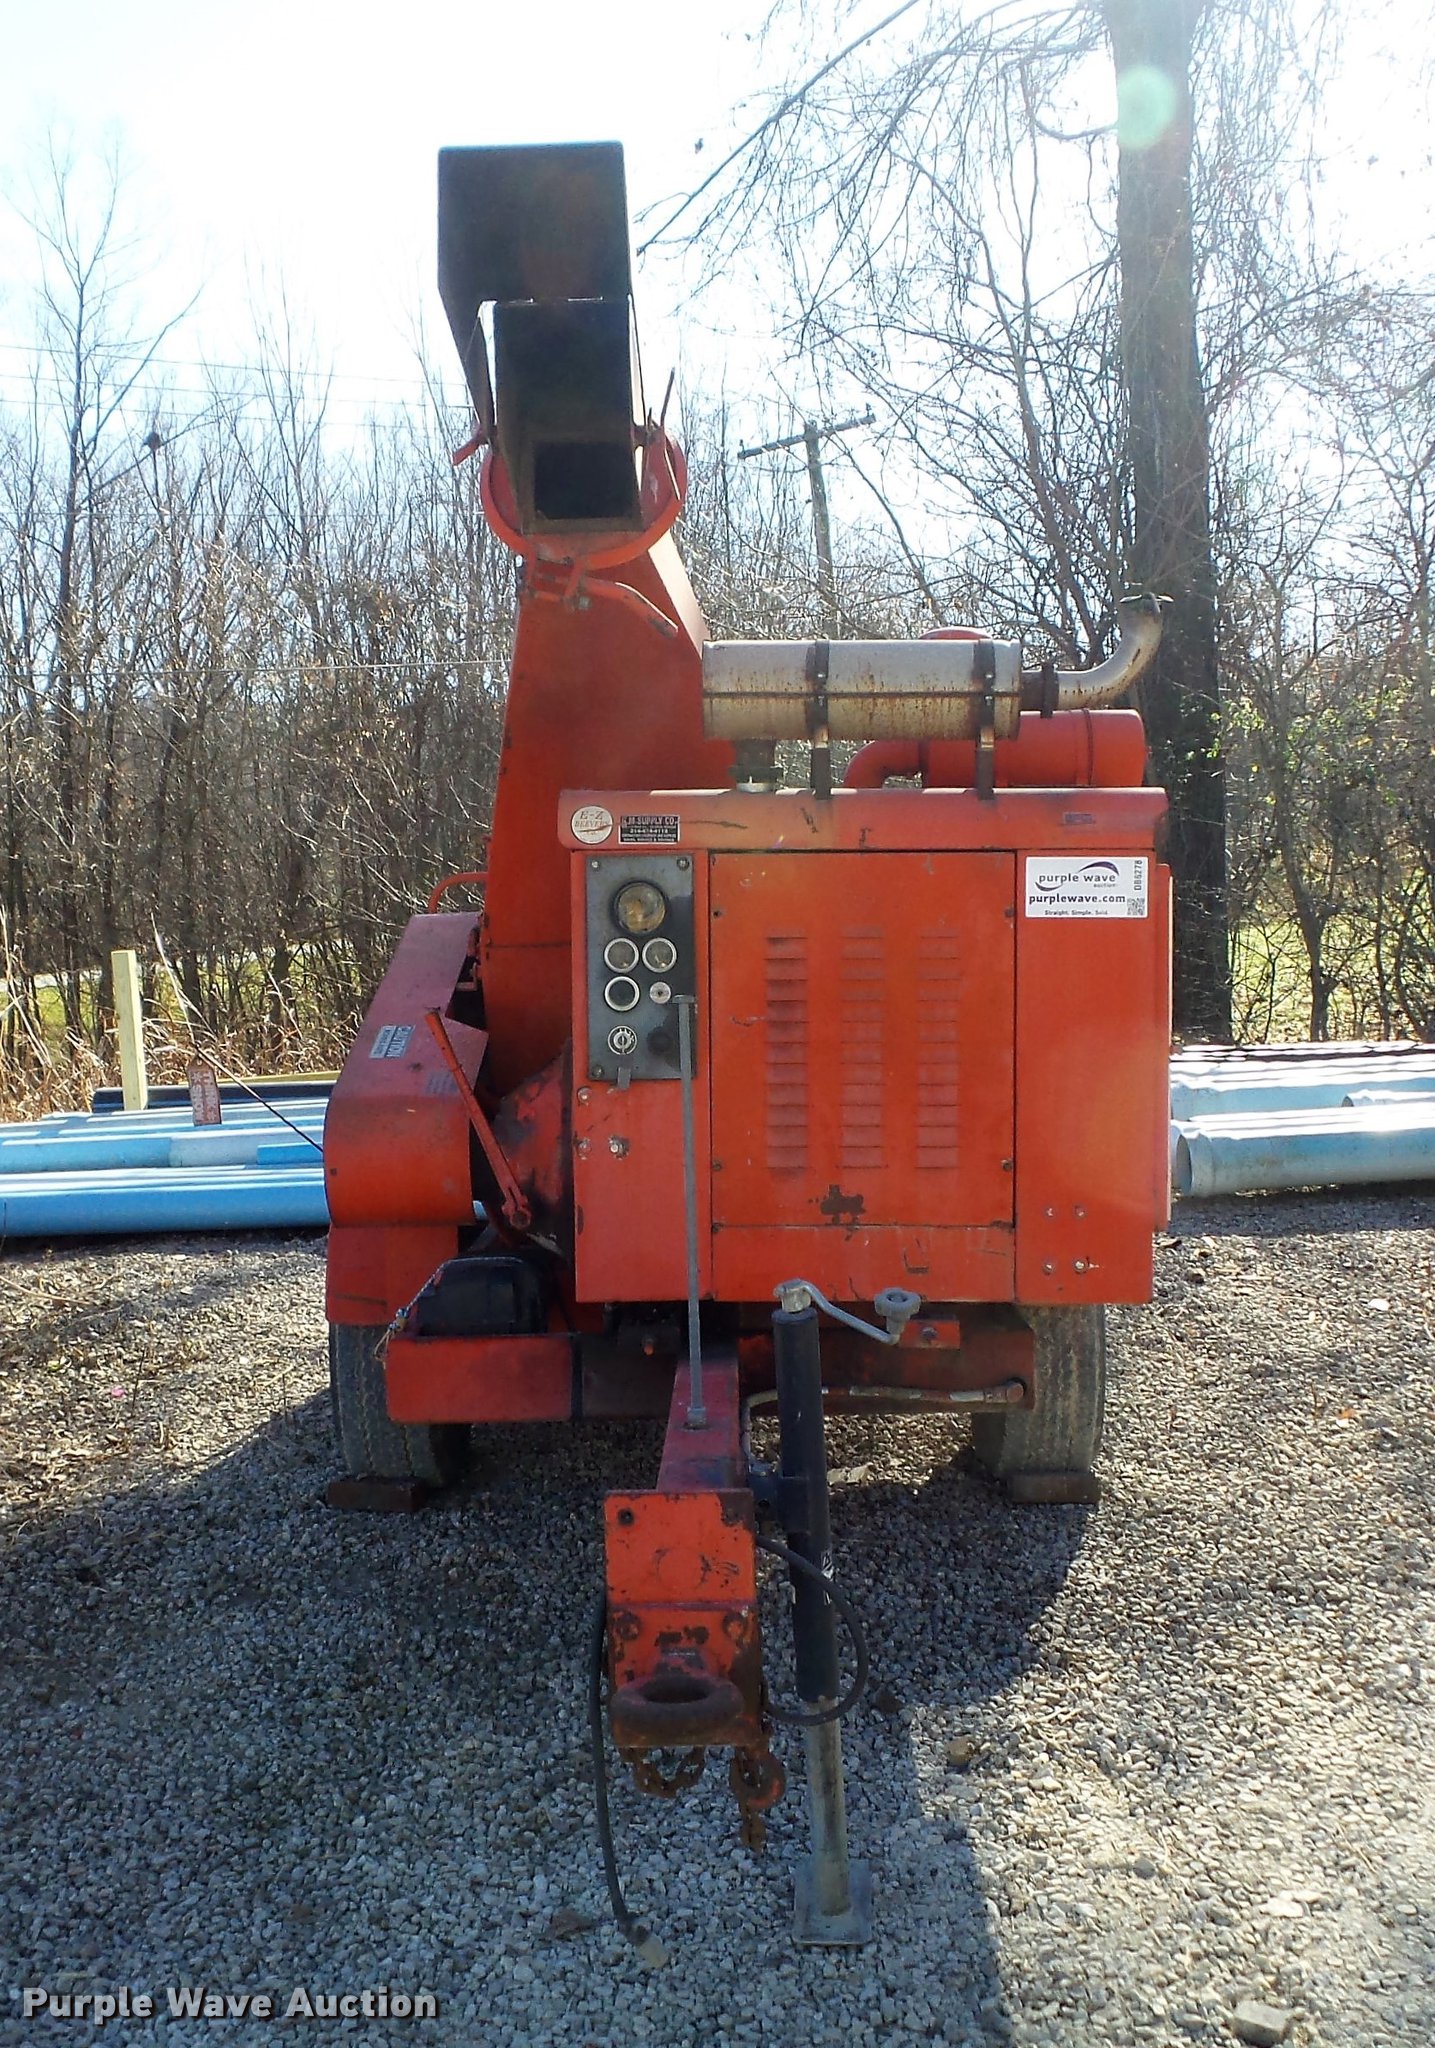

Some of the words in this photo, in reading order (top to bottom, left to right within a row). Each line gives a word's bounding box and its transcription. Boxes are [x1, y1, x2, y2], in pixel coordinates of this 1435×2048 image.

[580, 810, 604, 820] E-Z
[1039, 873, 1079, 884] purple
[1083, 874, 1116, 883] wave
[1029, 893, 1126, 905] purplewave.com
